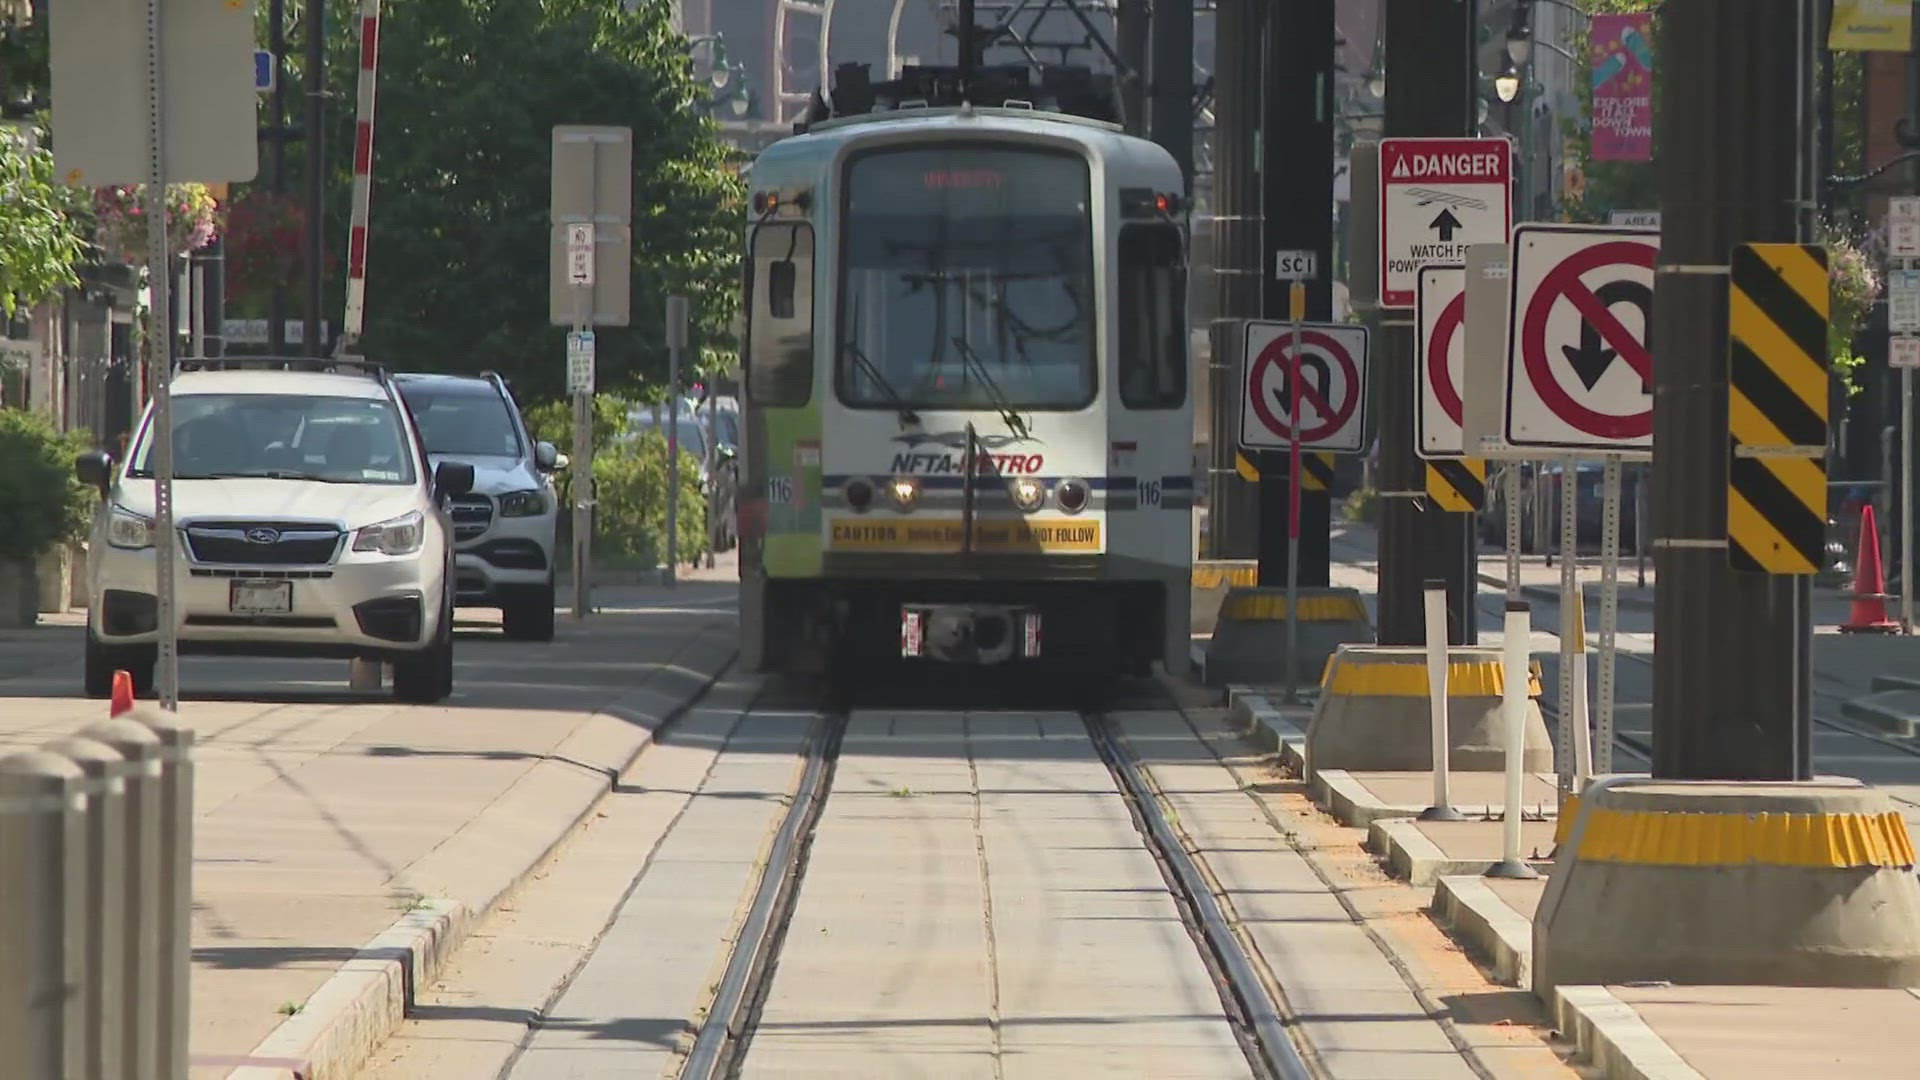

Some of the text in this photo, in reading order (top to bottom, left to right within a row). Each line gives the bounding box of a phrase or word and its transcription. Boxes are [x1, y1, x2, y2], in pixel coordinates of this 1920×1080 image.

[1413, 154, 1499, 176] DANGER
[1625, 216, 1656, 226] AREA
[1410, 244, 1453, 258] WATCH
[1281, 257, 1312, 273] SCI
[768, 478, 792, 504] 116
[1137, 480, 1160, 505] 116
[832, 526, 897, 541] CAUTION
[1056, 527, 1095, 543] FOLLOW
